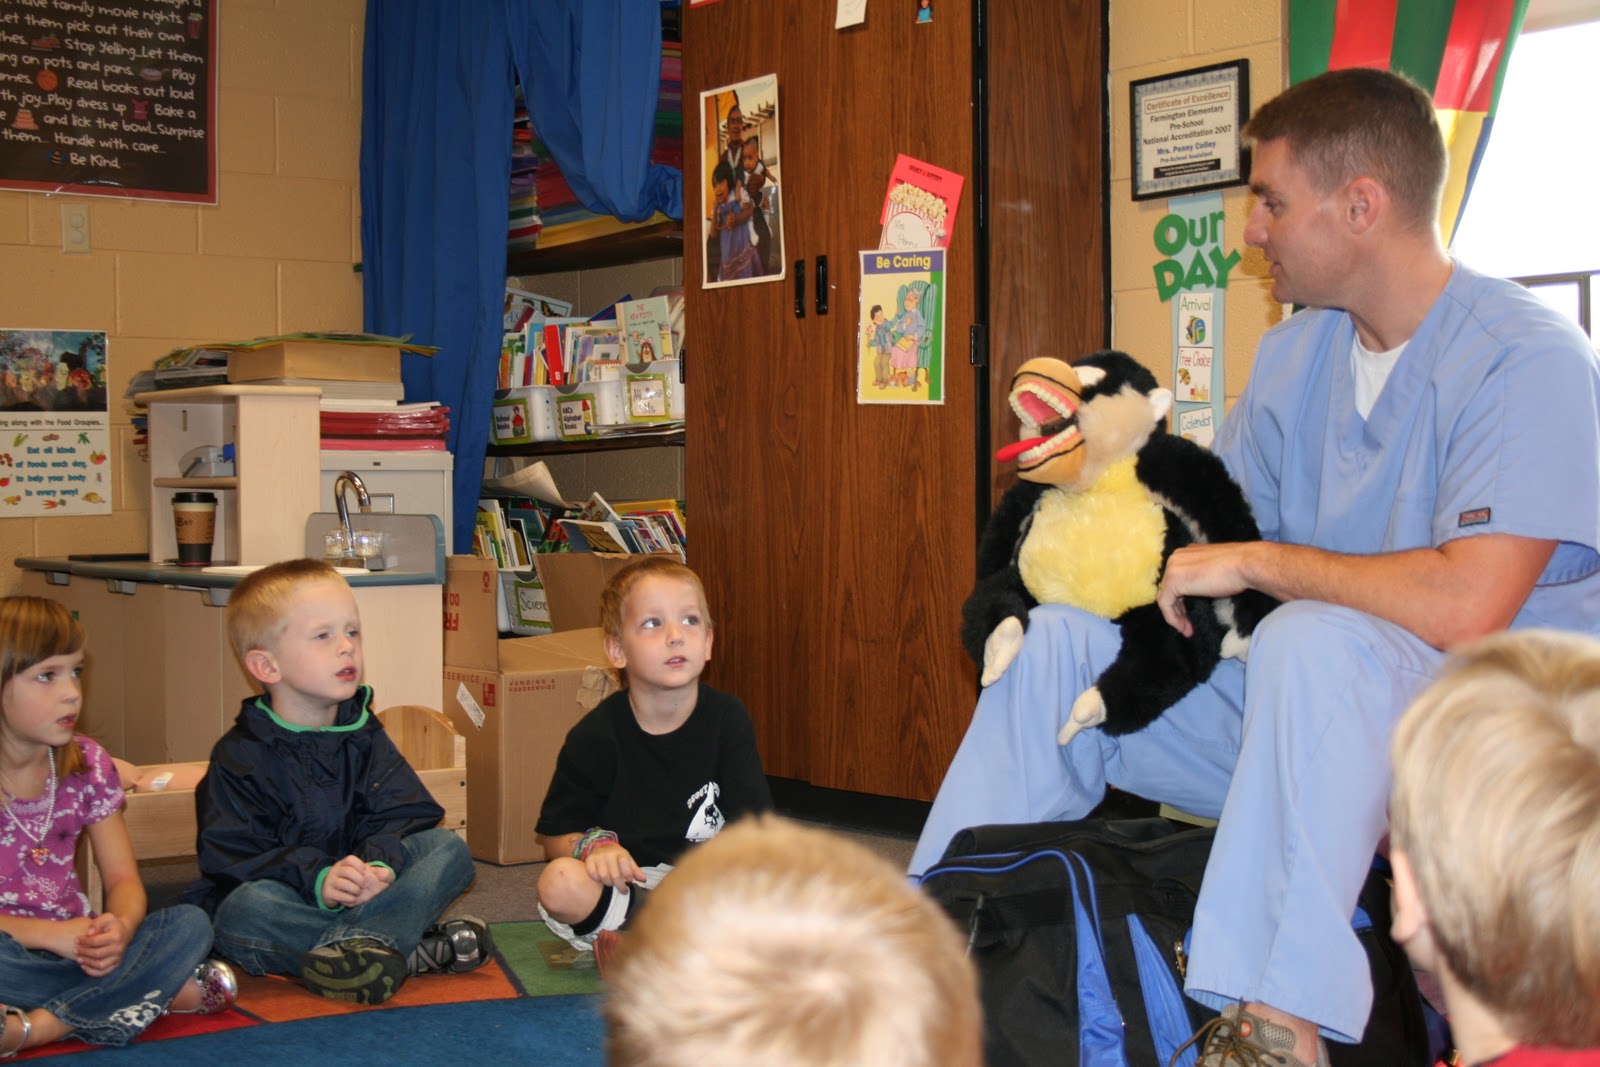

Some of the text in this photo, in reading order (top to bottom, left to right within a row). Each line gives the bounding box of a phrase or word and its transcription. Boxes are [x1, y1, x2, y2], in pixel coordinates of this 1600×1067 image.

[52, 0, 95, 18] family
[98, 6, 139, 19] movie
[24, 13, 63, 29] them
[66, 20, 91, 35] pick
[94, 24, 118, 35] out
[122, 25, 154, 39] their
[158, 32, 185, 42] own
[64, 38, 95, 56] Stop
[167, 48, 204, 64] them
[22, 55, 40, 65] on
[43, 56, 73, 71] pots
[76, 60, 100, 72] and
[172, 67, 197, 86] Play
[66, 76, 99, 91] Read
[101, 79, 140, 96] books
[142, 85, 166, 98] out
[169, 85, 195, 100] loud
[76, 97, 110, 112] dress
[112, 102, 127, 117] up
[154, 103, 184, 118] Bake
[187, 110, 196, 120] a
[1146, 99, 1183, 111] Certificate
[1192, 91, 1229, 103] Excellence
[43, 114, 68, 126] and
[71, 113, 92, 128] lick
[95, 117, 119, 131] the
[1150, 105, 1224, 123] Farmington Elementary
[1169, 119, 1204, 131] Pre-School
[54, 131, 97, 148] Handle
[99, 137, 129, 151] with
[1143, 125, 1232, 145] National Accreditation 2007
[69, 152, 87, 166] Be
[1157, 148, 1172, 156] Mrs.
[1173, 144, 1193, 153] Penny
[1153, 210, 1226, 256] Our
[876, 254, 932, 270] Be Caring
[1152, 245, 1243, 303] DAY
[1180, 295, 1212, 311] Arrival
[1179, 349, 1211, 368] Free Choice
[11, 419, 28, 428] along
[56, 418, 72, 426] Food
[497, 422, 510, 430] Books
[563, 414, 582, 422] Alphabet
[564, 422, 577, 430] Books
[1181, 411, 1212, 431] Calendar
[57, 446, 76, 454] kinds
[51, 460, 69, 468] each
[27, 474, 44, 484] help
[47, 475, 65, 484] your
[68, 474, 87, 483] body
[36, 489, 57, 498] every
[520, 591, 548, 612] Scienc
